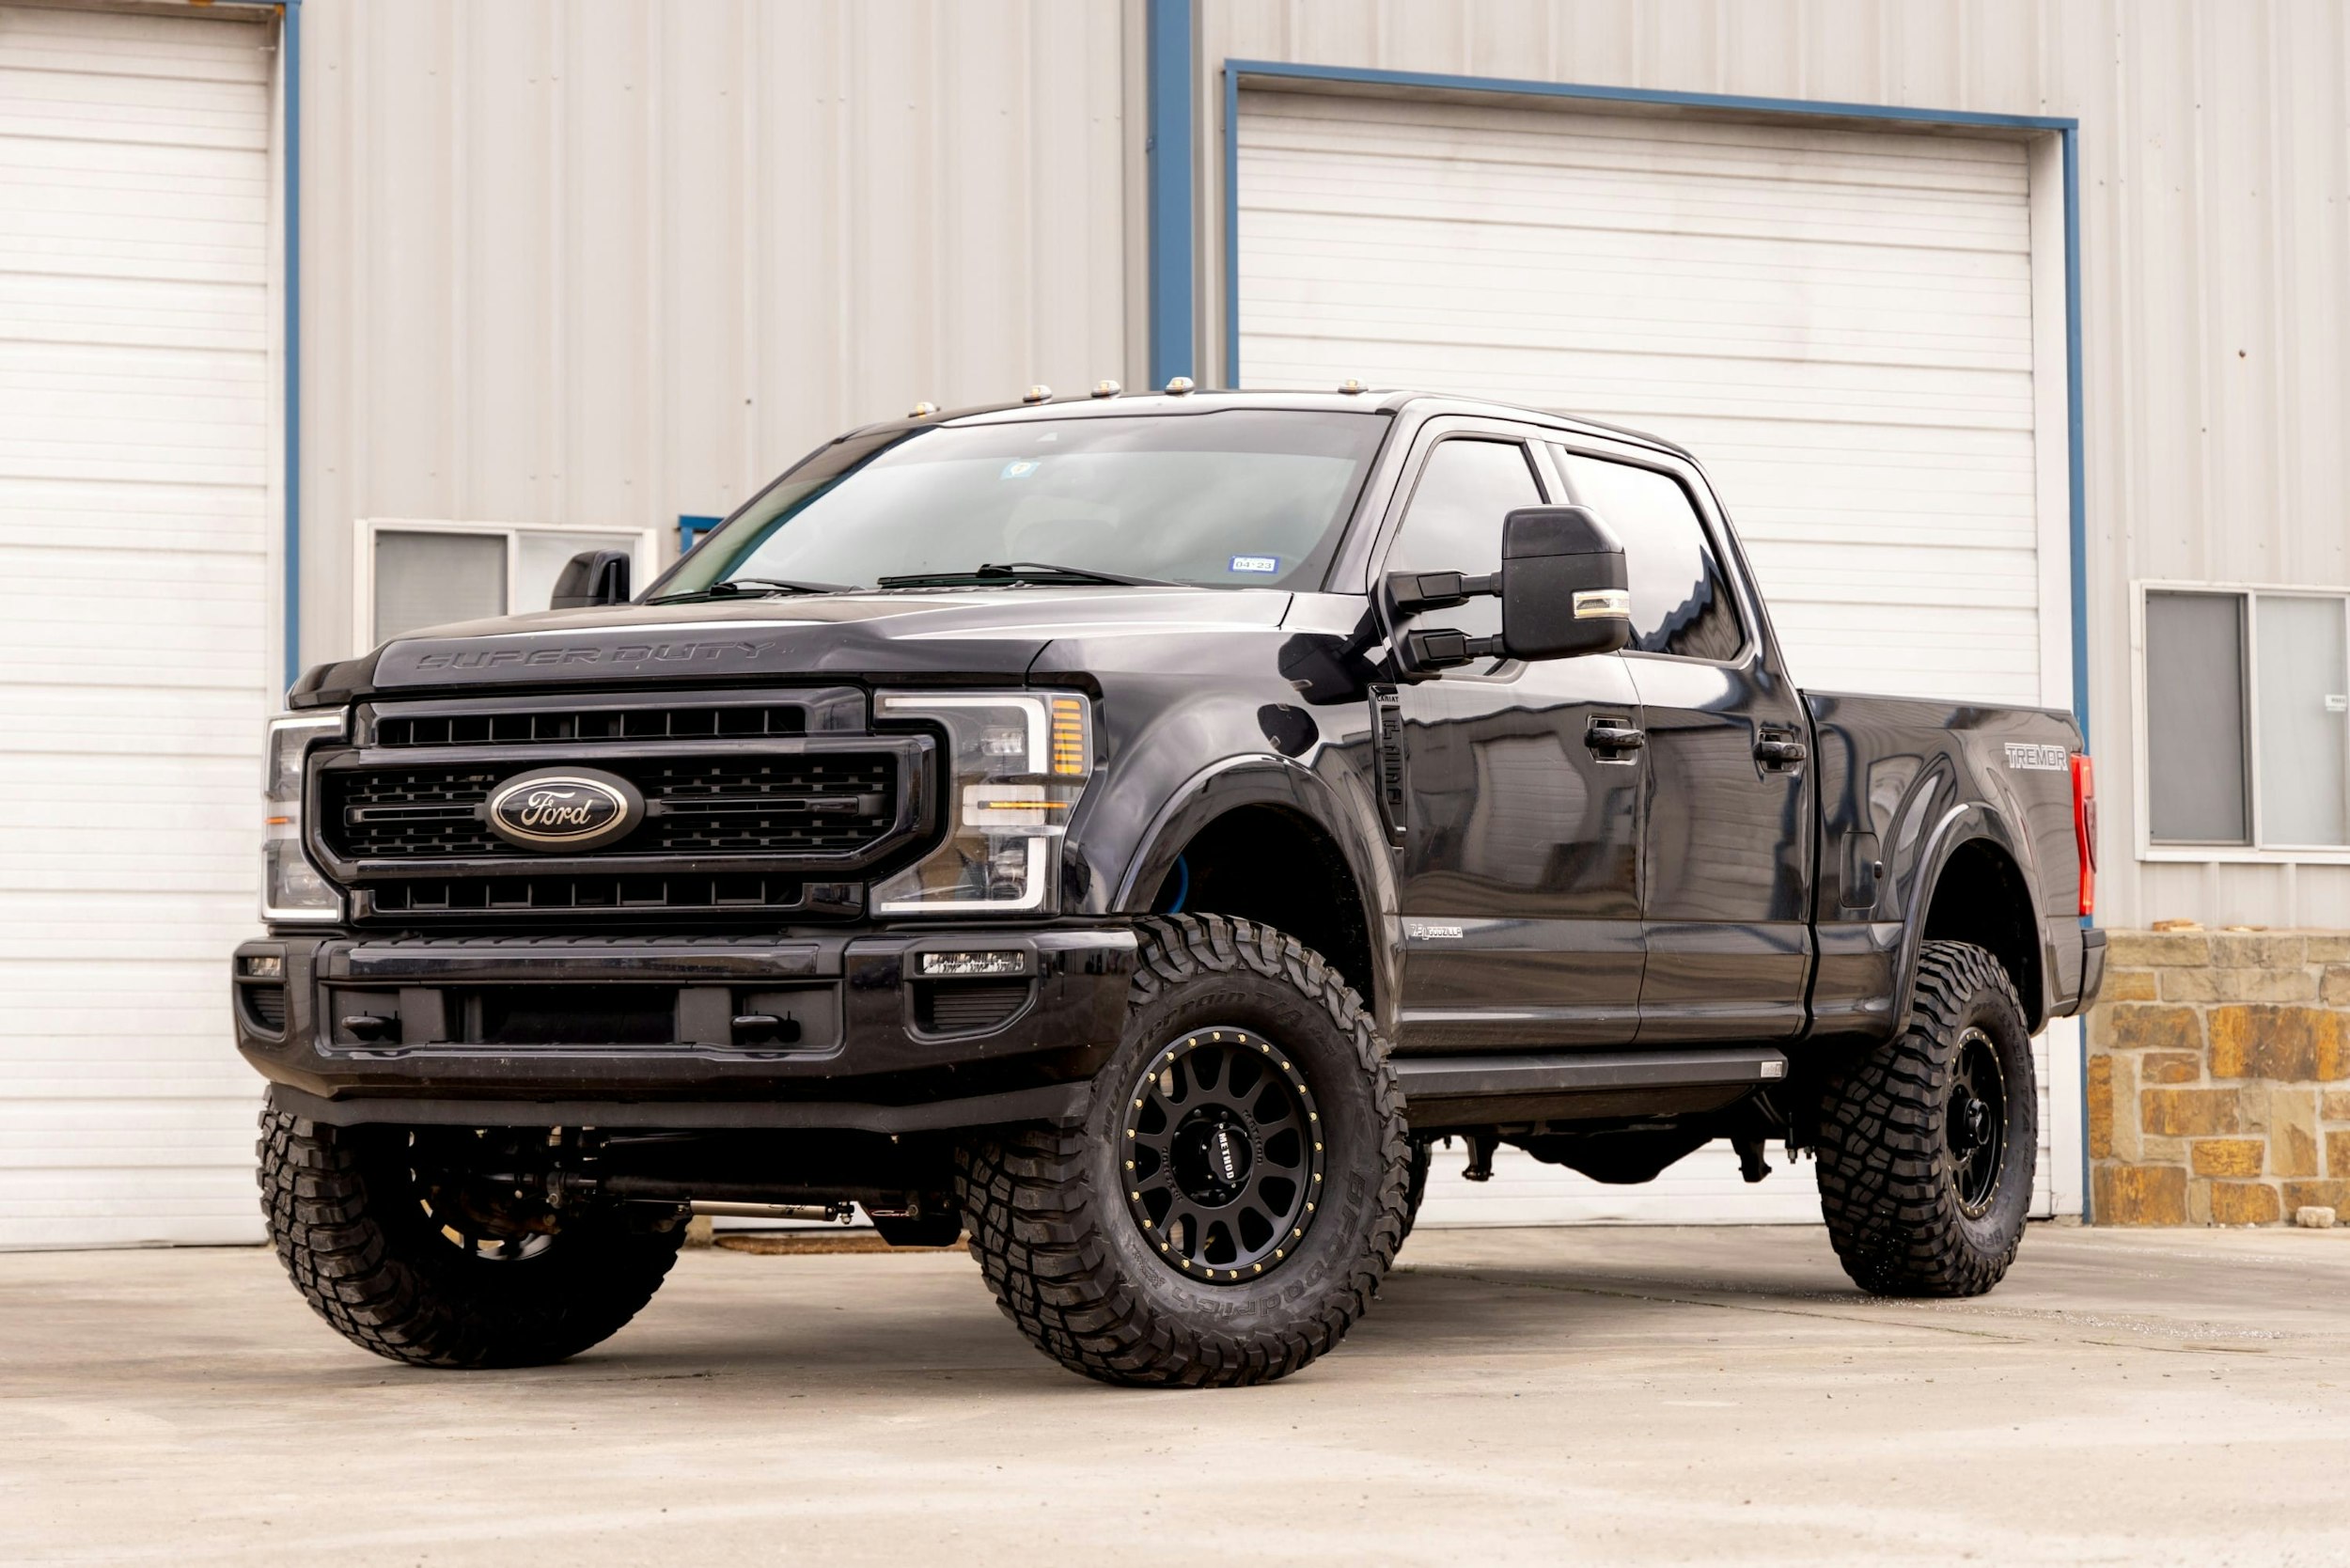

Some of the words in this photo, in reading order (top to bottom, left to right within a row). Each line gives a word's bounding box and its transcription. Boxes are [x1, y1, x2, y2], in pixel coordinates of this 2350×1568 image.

[415, 647, 602, 670] SUPER
[610, 641, 776, 663] DUTY
[2004, 743, 2068, 771] TREMOR
[521, 790, 592, 826] Ford
[1218, 1132, 1235, 1180] METHOD
[1171, 1170, 1367, 1320] BFGoodrich
